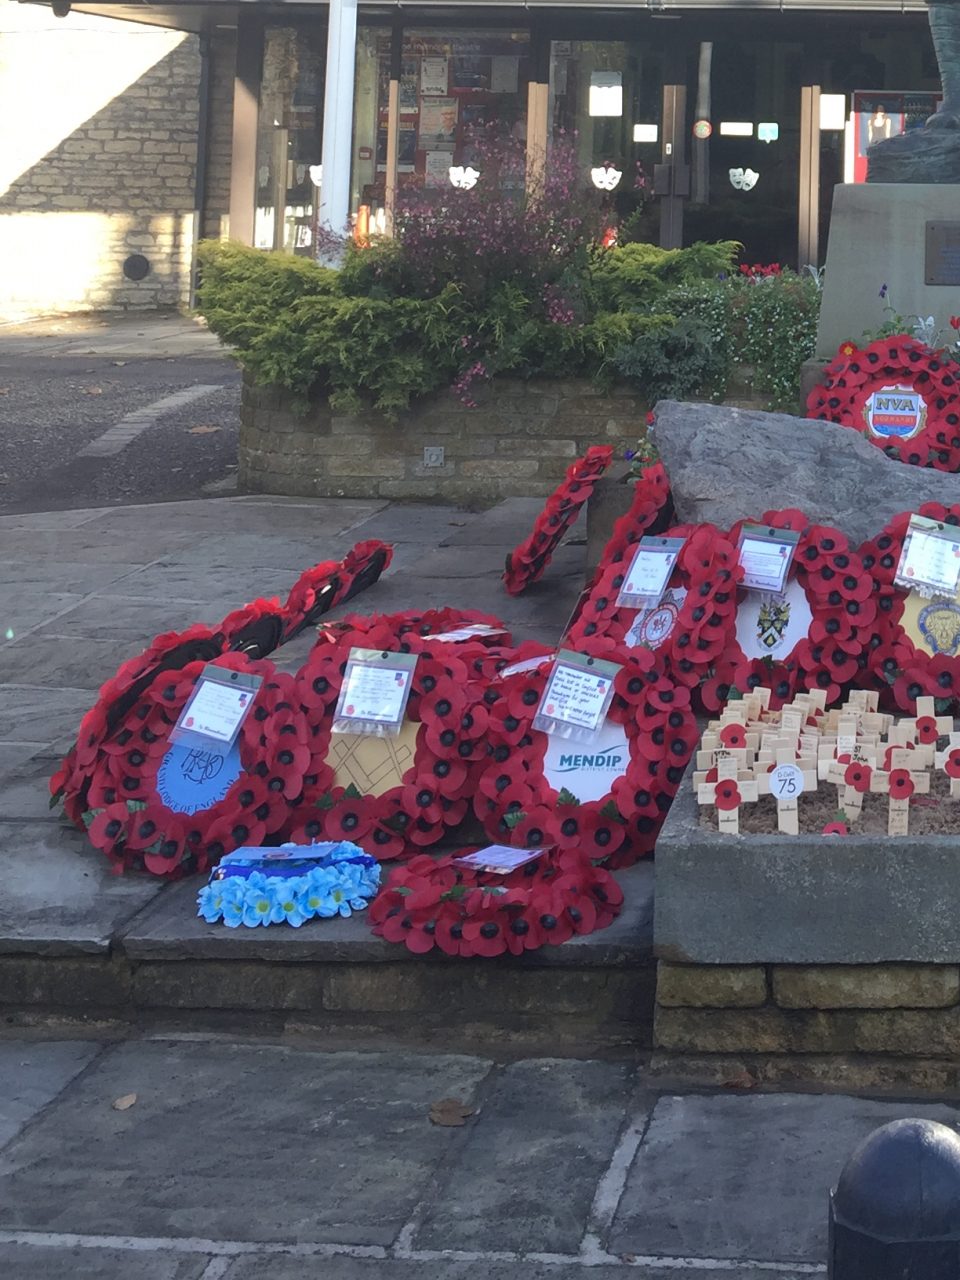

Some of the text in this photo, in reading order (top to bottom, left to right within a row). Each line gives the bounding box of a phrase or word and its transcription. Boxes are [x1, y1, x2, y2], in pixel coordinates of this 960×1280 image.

[876, 397, 915, 411] NVA
[559, 754, 622, 768] MENDIP
[778, 778, 796, 794] 75
